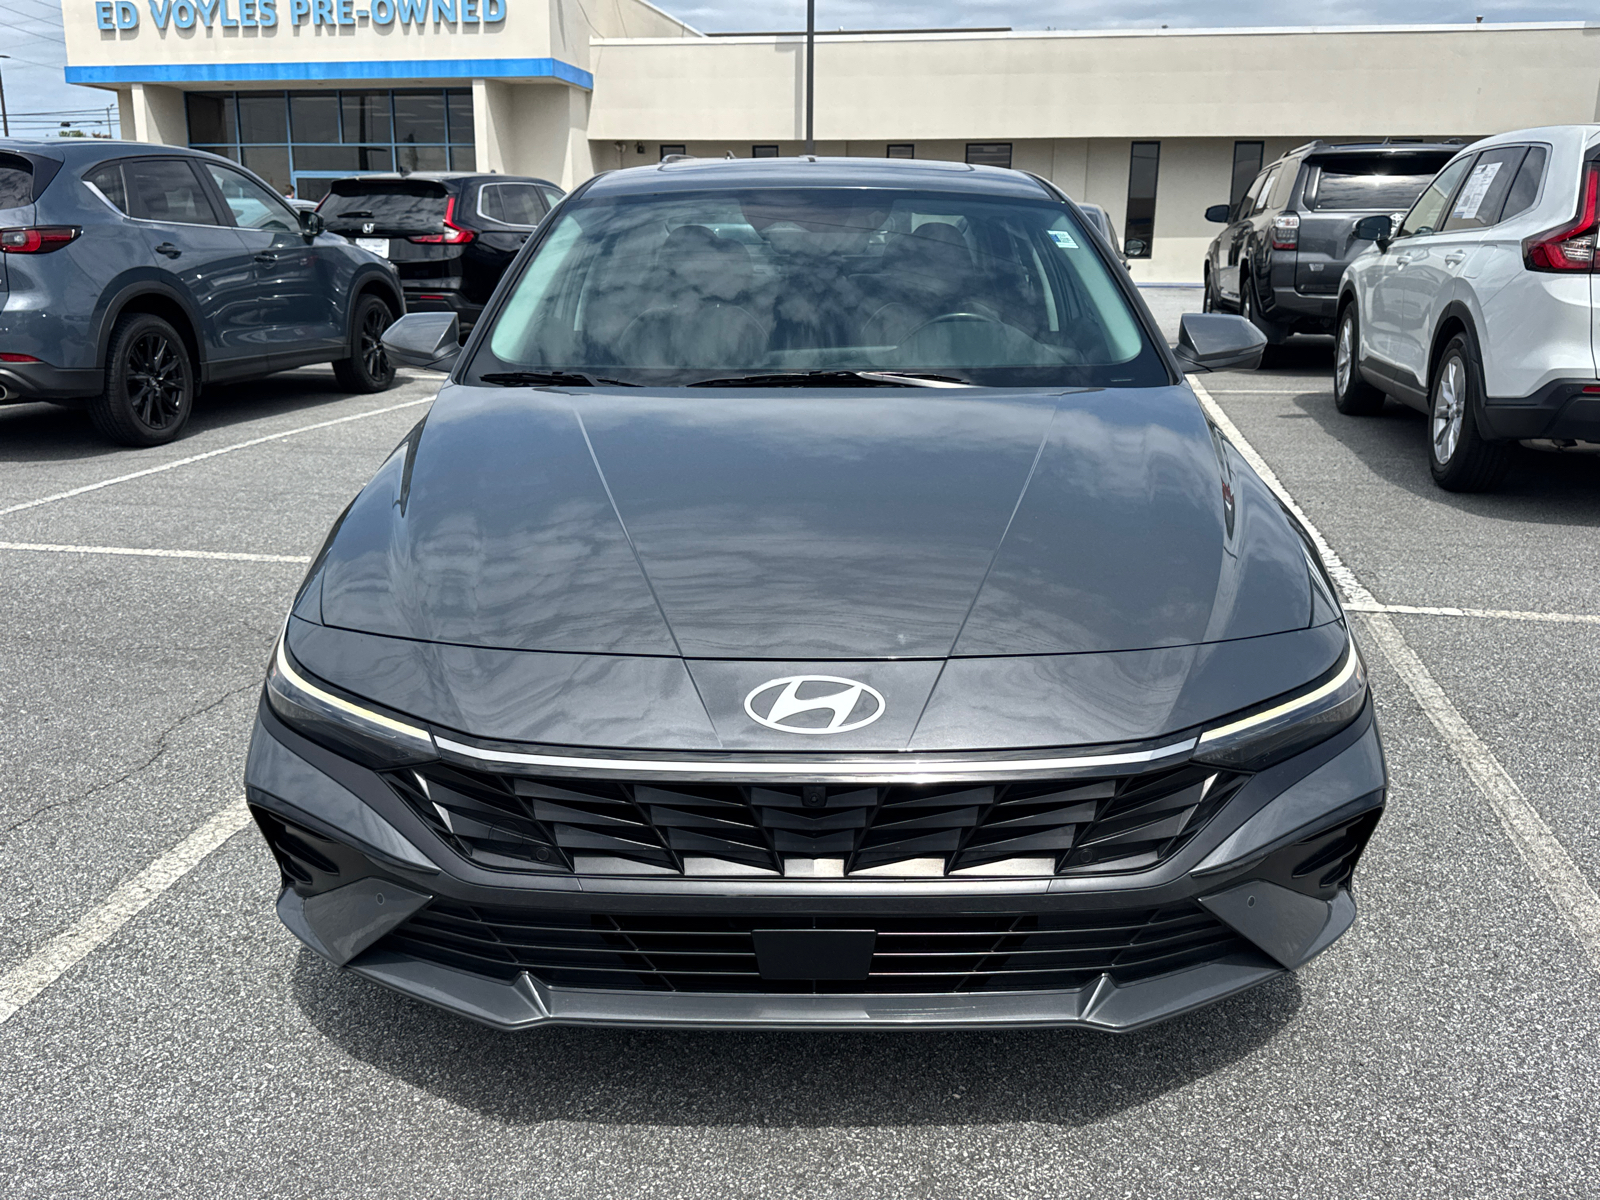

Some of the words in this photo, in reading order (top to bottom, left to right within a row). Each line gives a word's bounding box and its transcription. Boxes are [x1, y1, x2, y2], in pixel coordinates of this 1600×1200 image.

[95, 1, 138, 29] ED
[149, 0, 278, 28] VOYLES
[290, 0, 507, 25] PRE-OWNED
